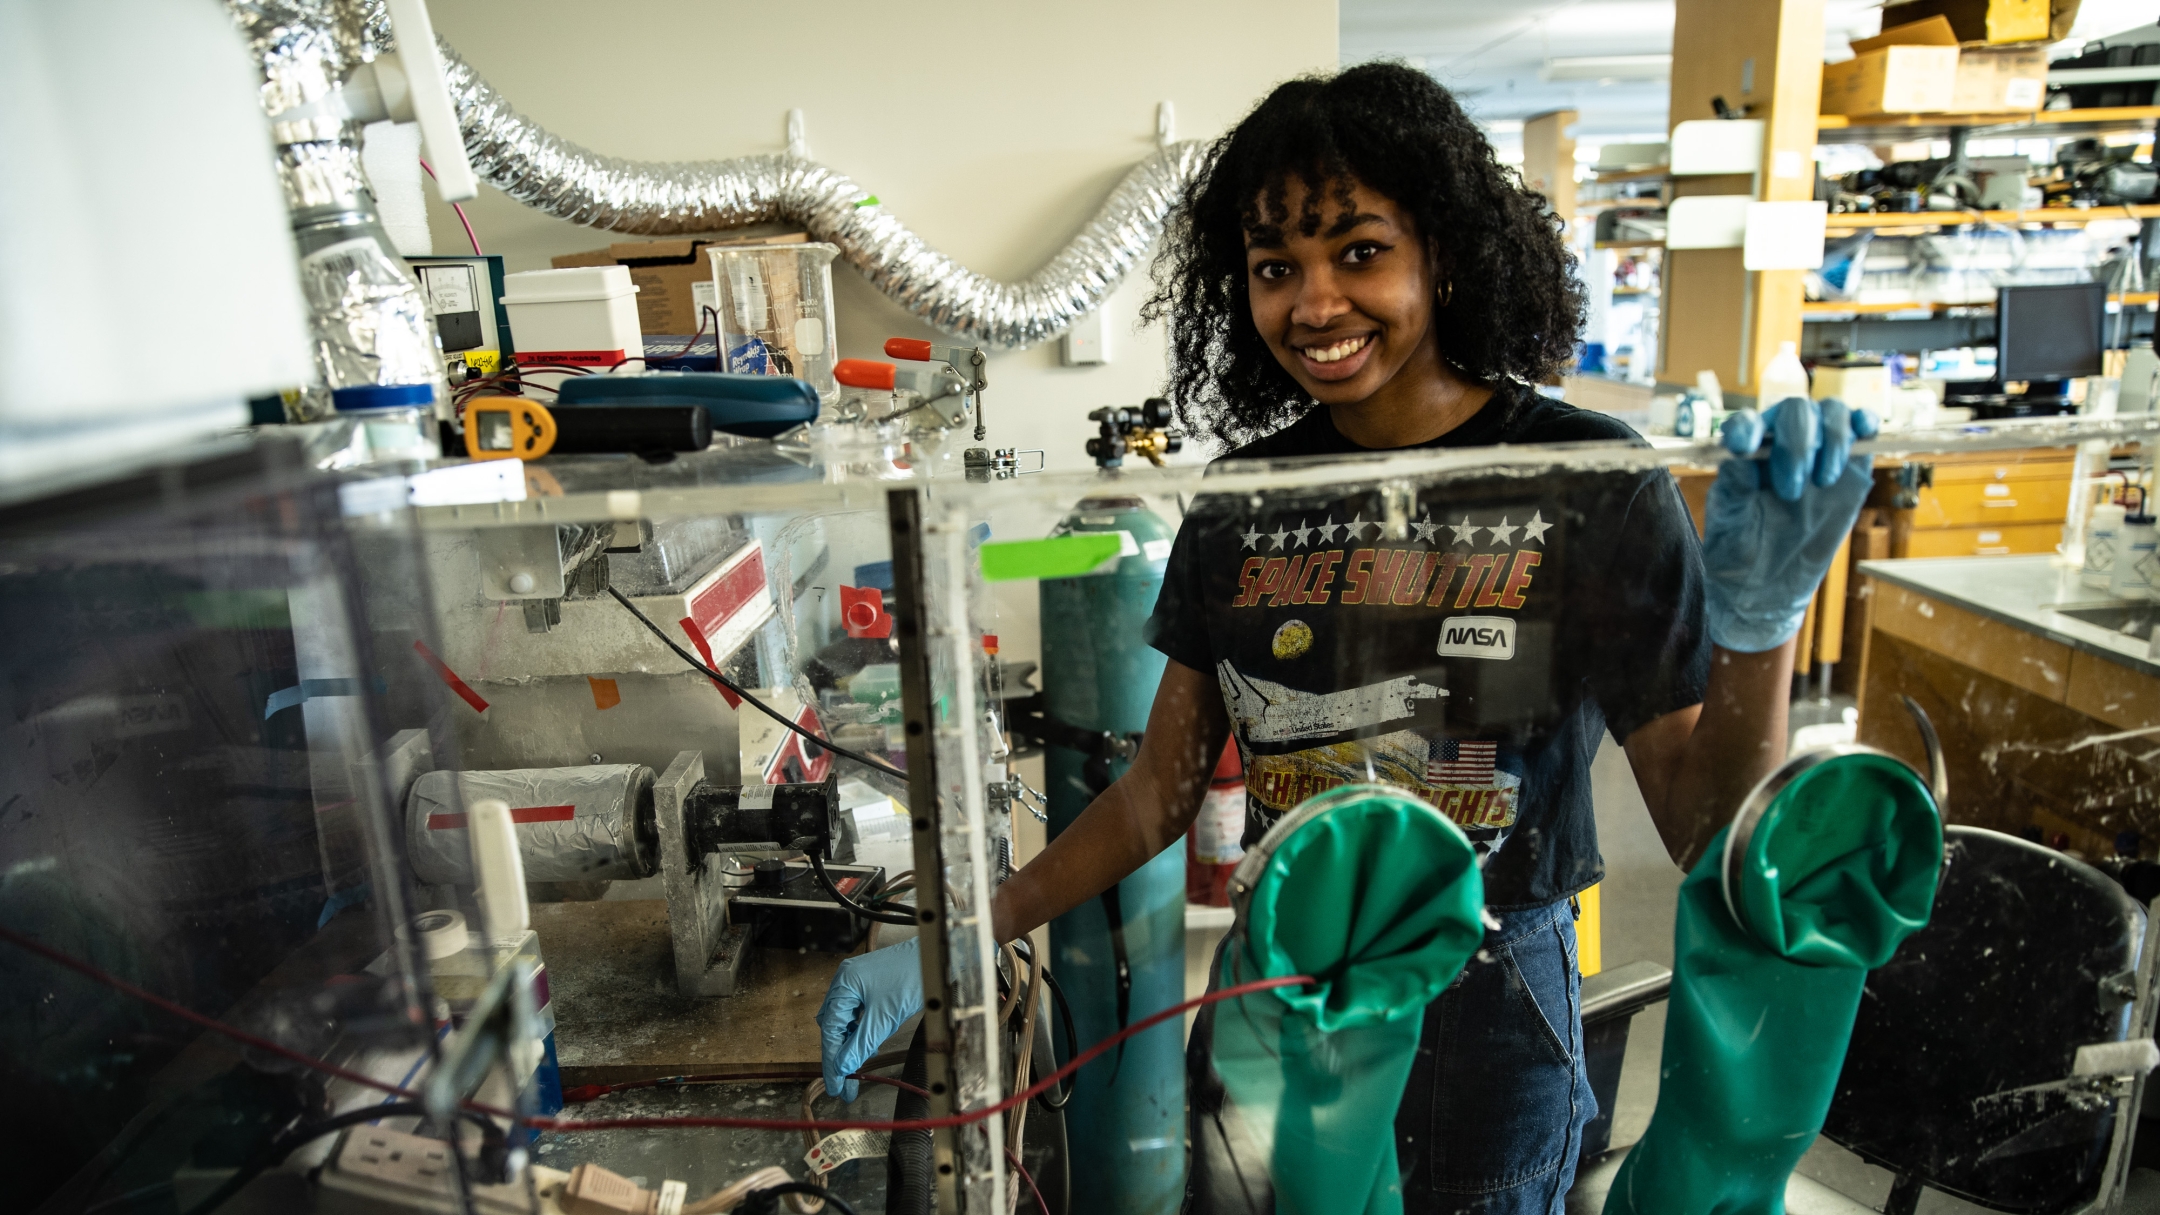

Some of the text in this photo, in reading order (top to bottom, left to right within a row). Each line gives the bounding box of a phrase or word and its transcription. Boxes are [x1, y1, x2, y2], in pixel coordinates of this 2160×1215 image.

[732, 345, 760, 368] Reynolds
[1232, 548, 1542, 610] SPACE SHUTTLE
[1444, 627, 1507, 648] NASA
[1290, 721, 1334, 733] United States
[1248, 758, 1293, 805] RCH
[1408, 787, 1513, 825] IGHTS
